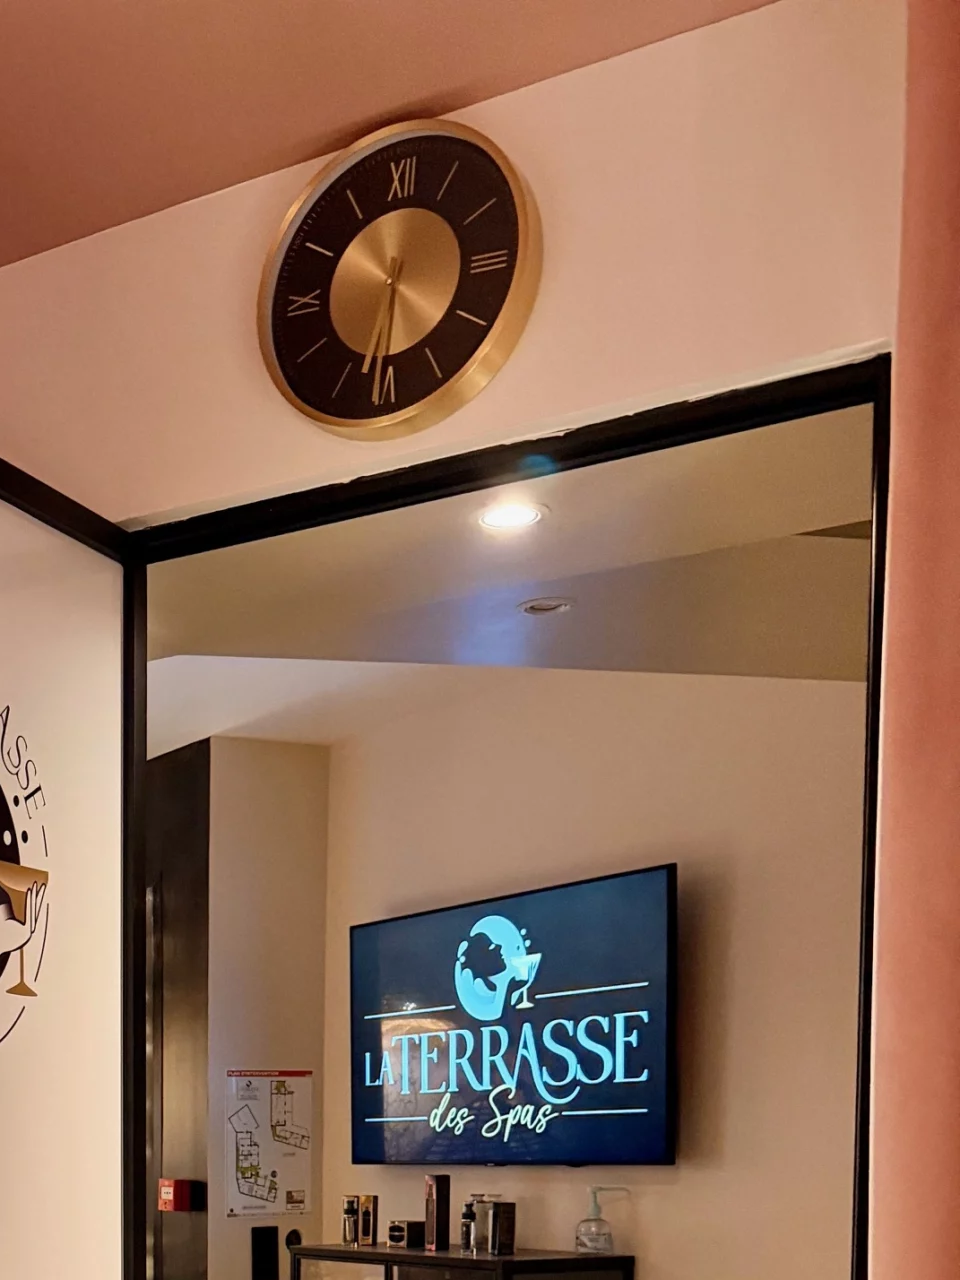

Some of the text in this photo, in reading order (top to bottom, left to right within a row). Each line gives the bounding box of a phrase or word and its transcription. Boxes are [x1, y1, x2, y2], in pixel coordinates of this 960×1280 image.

[364, 1010, 650, 1105] LA TERRASSE
[429, 1084, 559, 1141] des Spas
